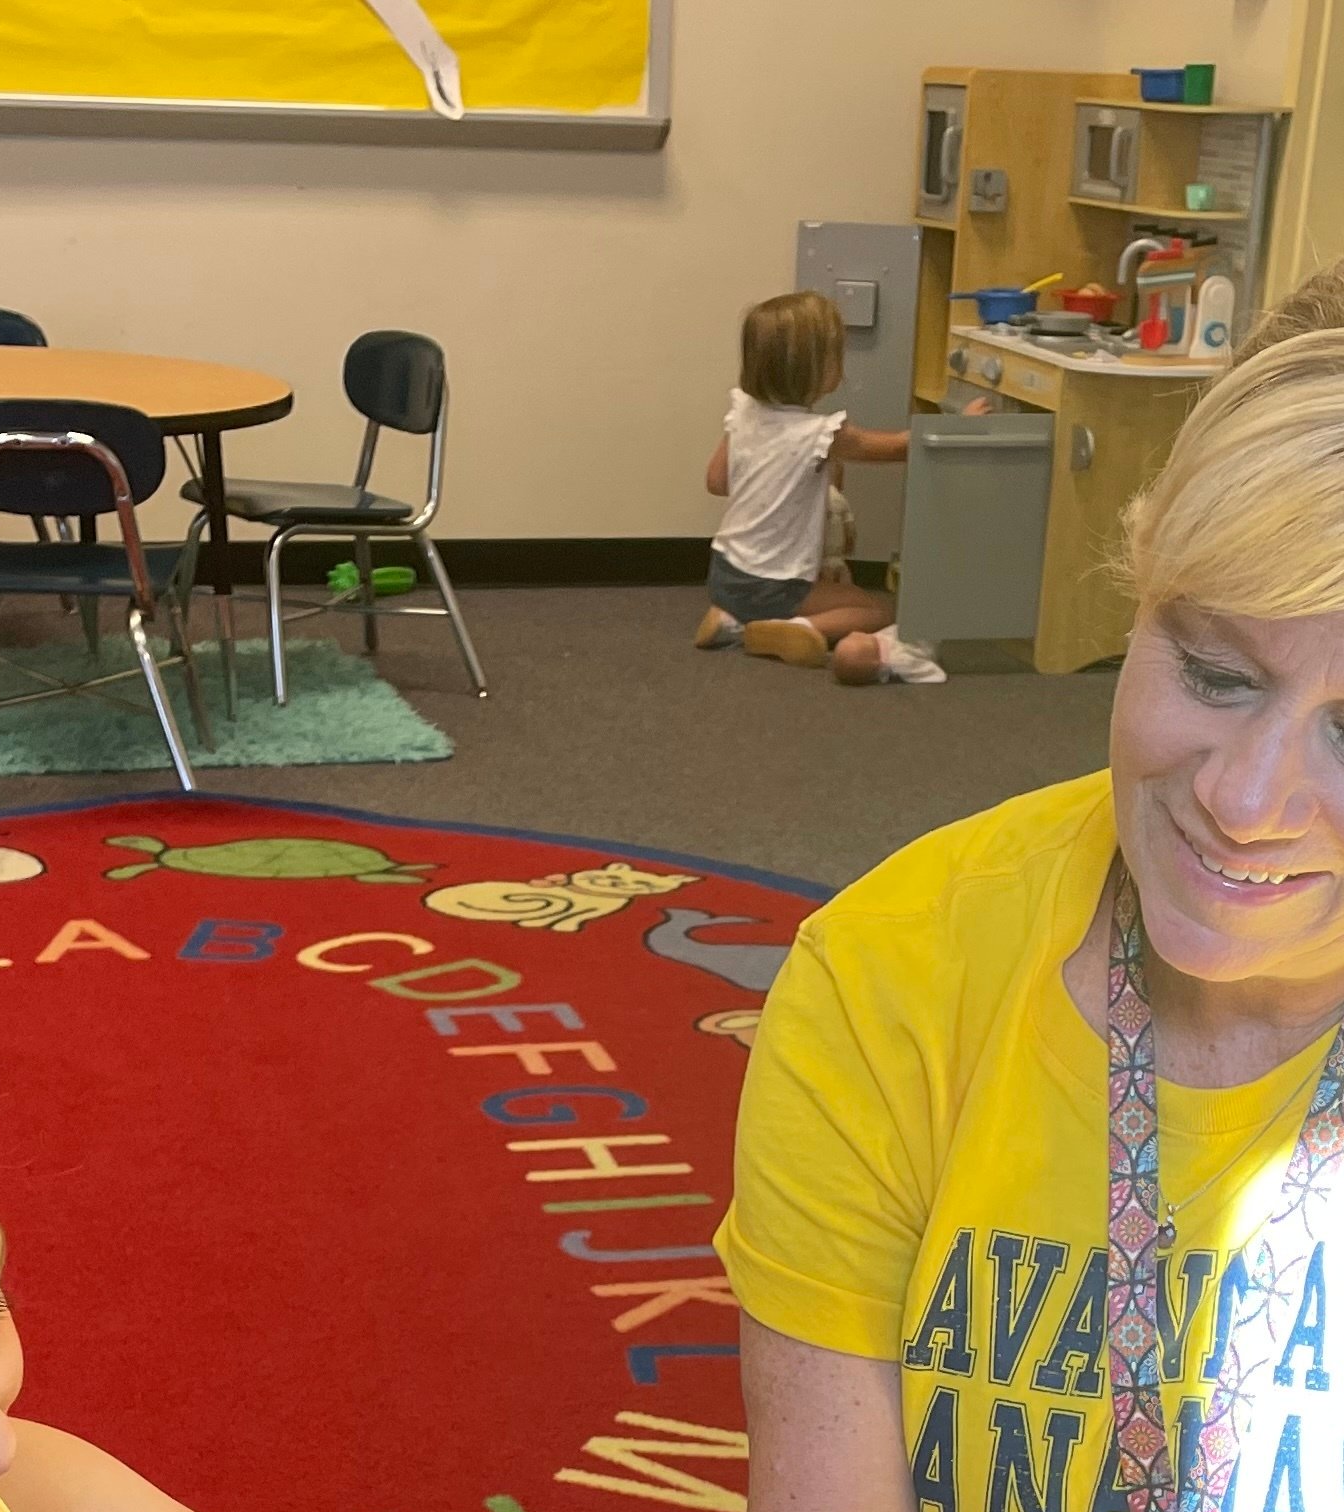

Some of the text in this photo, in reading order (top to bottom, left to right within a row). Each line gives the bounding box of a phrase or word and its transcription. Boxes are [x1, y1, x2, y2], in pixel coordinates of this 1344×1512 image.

[35, 918, 150, 962] A
[177, 920, 283, 961] B
[295, 931, 434, 972] C
[370, 958, 521, 1000] D
[424, 1002, 585, 1037] E
[448, 1041, 616, 1075] F
[481, 1085, 649, 1126] G
[506, 1134, 693, 1182] H
[559, 1230, 714, 1261] J
